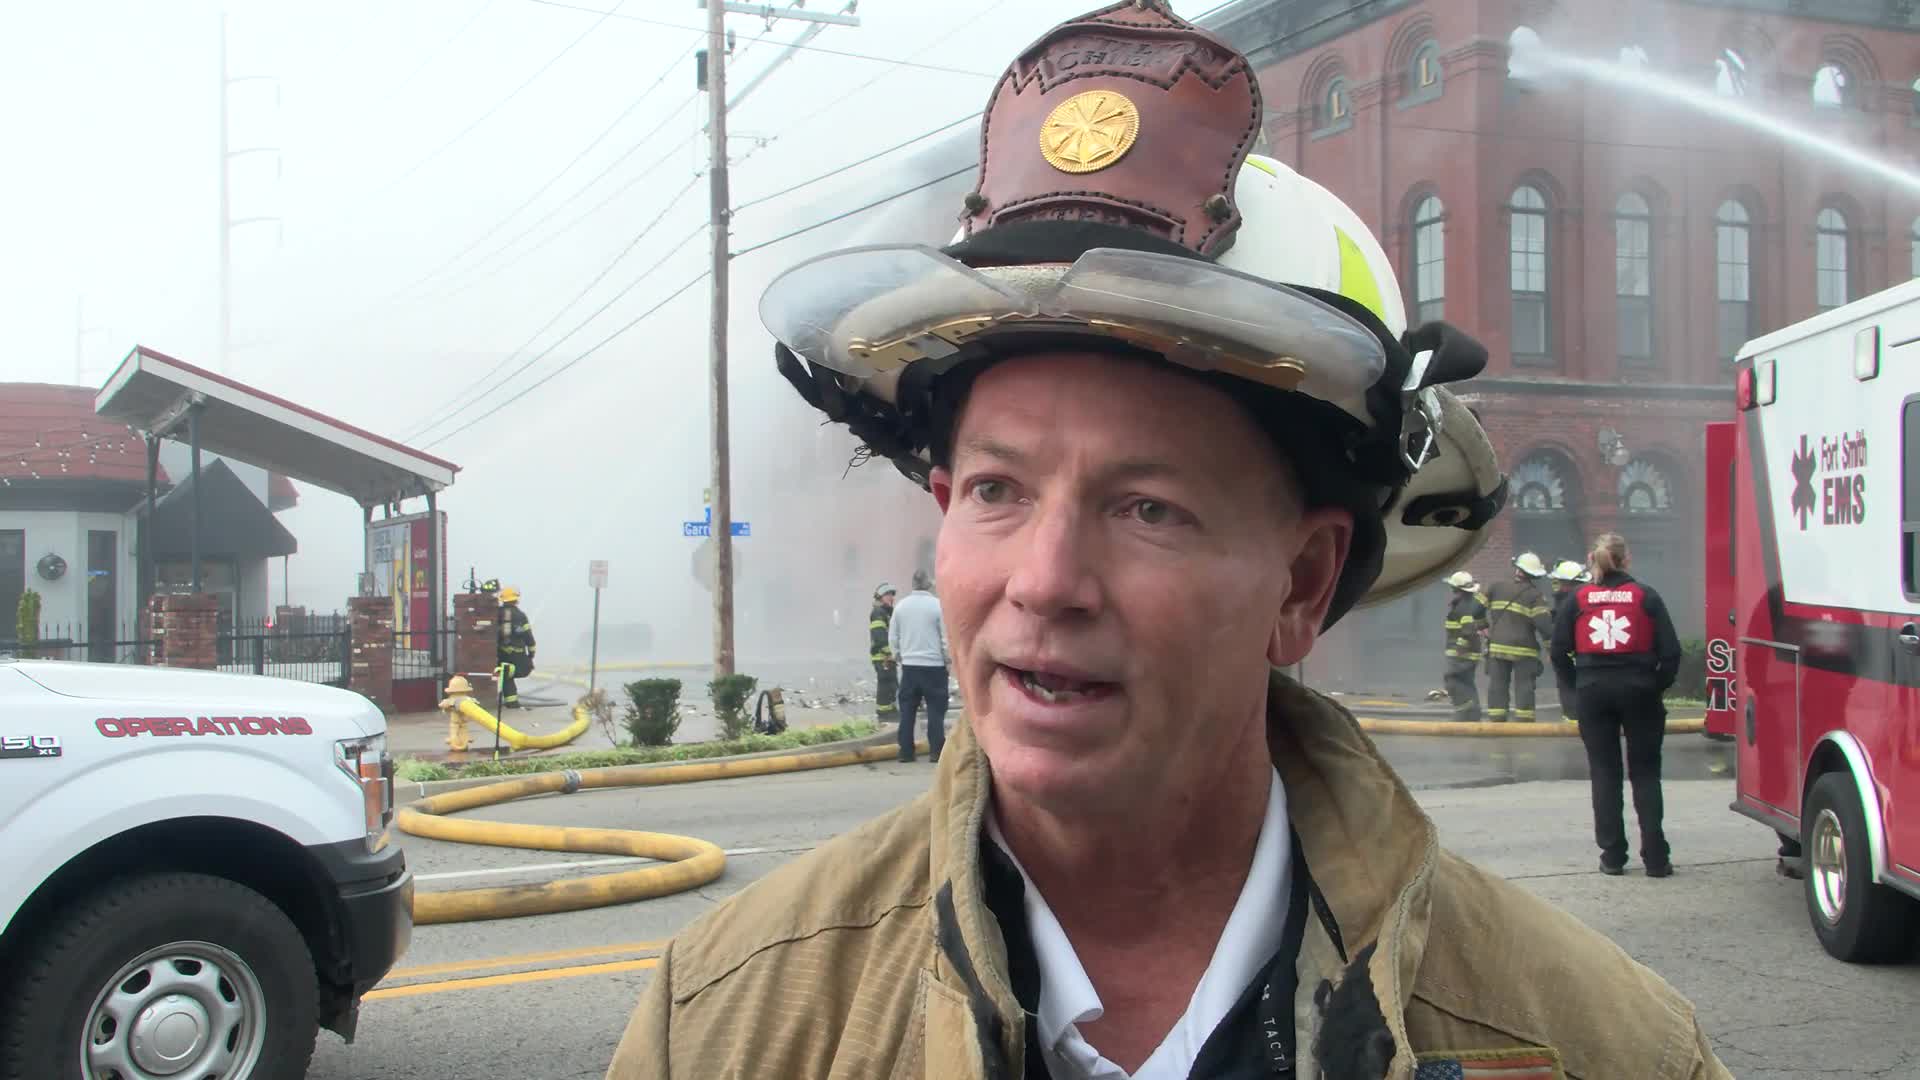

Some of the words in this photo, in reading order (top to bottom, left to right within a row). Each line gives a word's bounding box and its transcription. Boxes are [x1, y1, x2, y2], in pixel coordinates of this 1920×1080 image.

[1332, 90, 1346, 120] L
[1419, 57, 1435, 88] L
[1821, 434, 1840, 472] Fort
[1842, 429, 1868, 470] Smith
[1823, 474, 1866, 525] EMS
[685, 523, 712, 536] Garr
[1588, 591, 1633, 603] SUPERVISOR
[95, 716, 313, 738] OPERATIONS
[39, 748, 57, 756] XL
